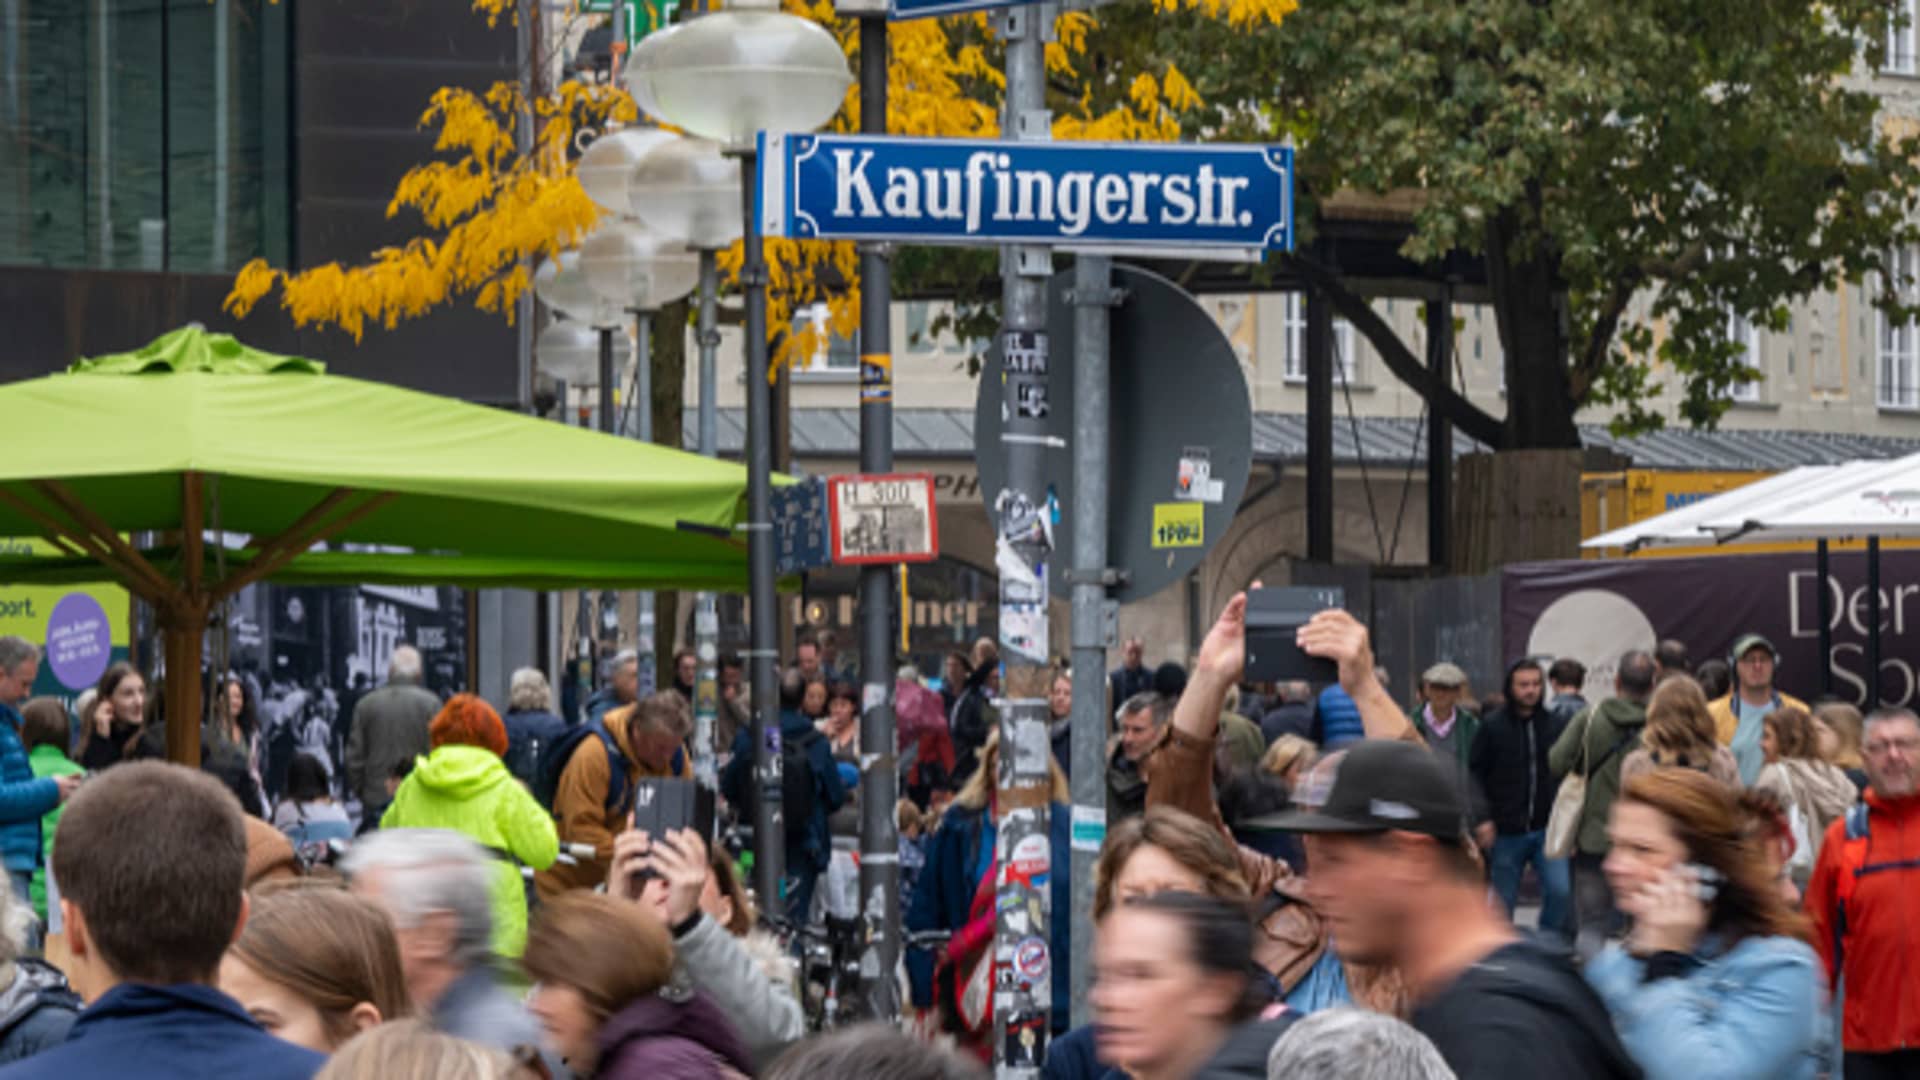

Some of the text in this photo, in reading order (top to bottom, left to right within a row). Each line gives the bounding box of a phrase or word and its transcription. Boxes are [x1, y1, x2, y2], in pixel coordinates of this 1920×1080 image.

[832, 149, 1253, 234] Kaufingerstr.
[1789, 570, 1919, 638] Der
[1829, 643, 1920, 707] Sp
